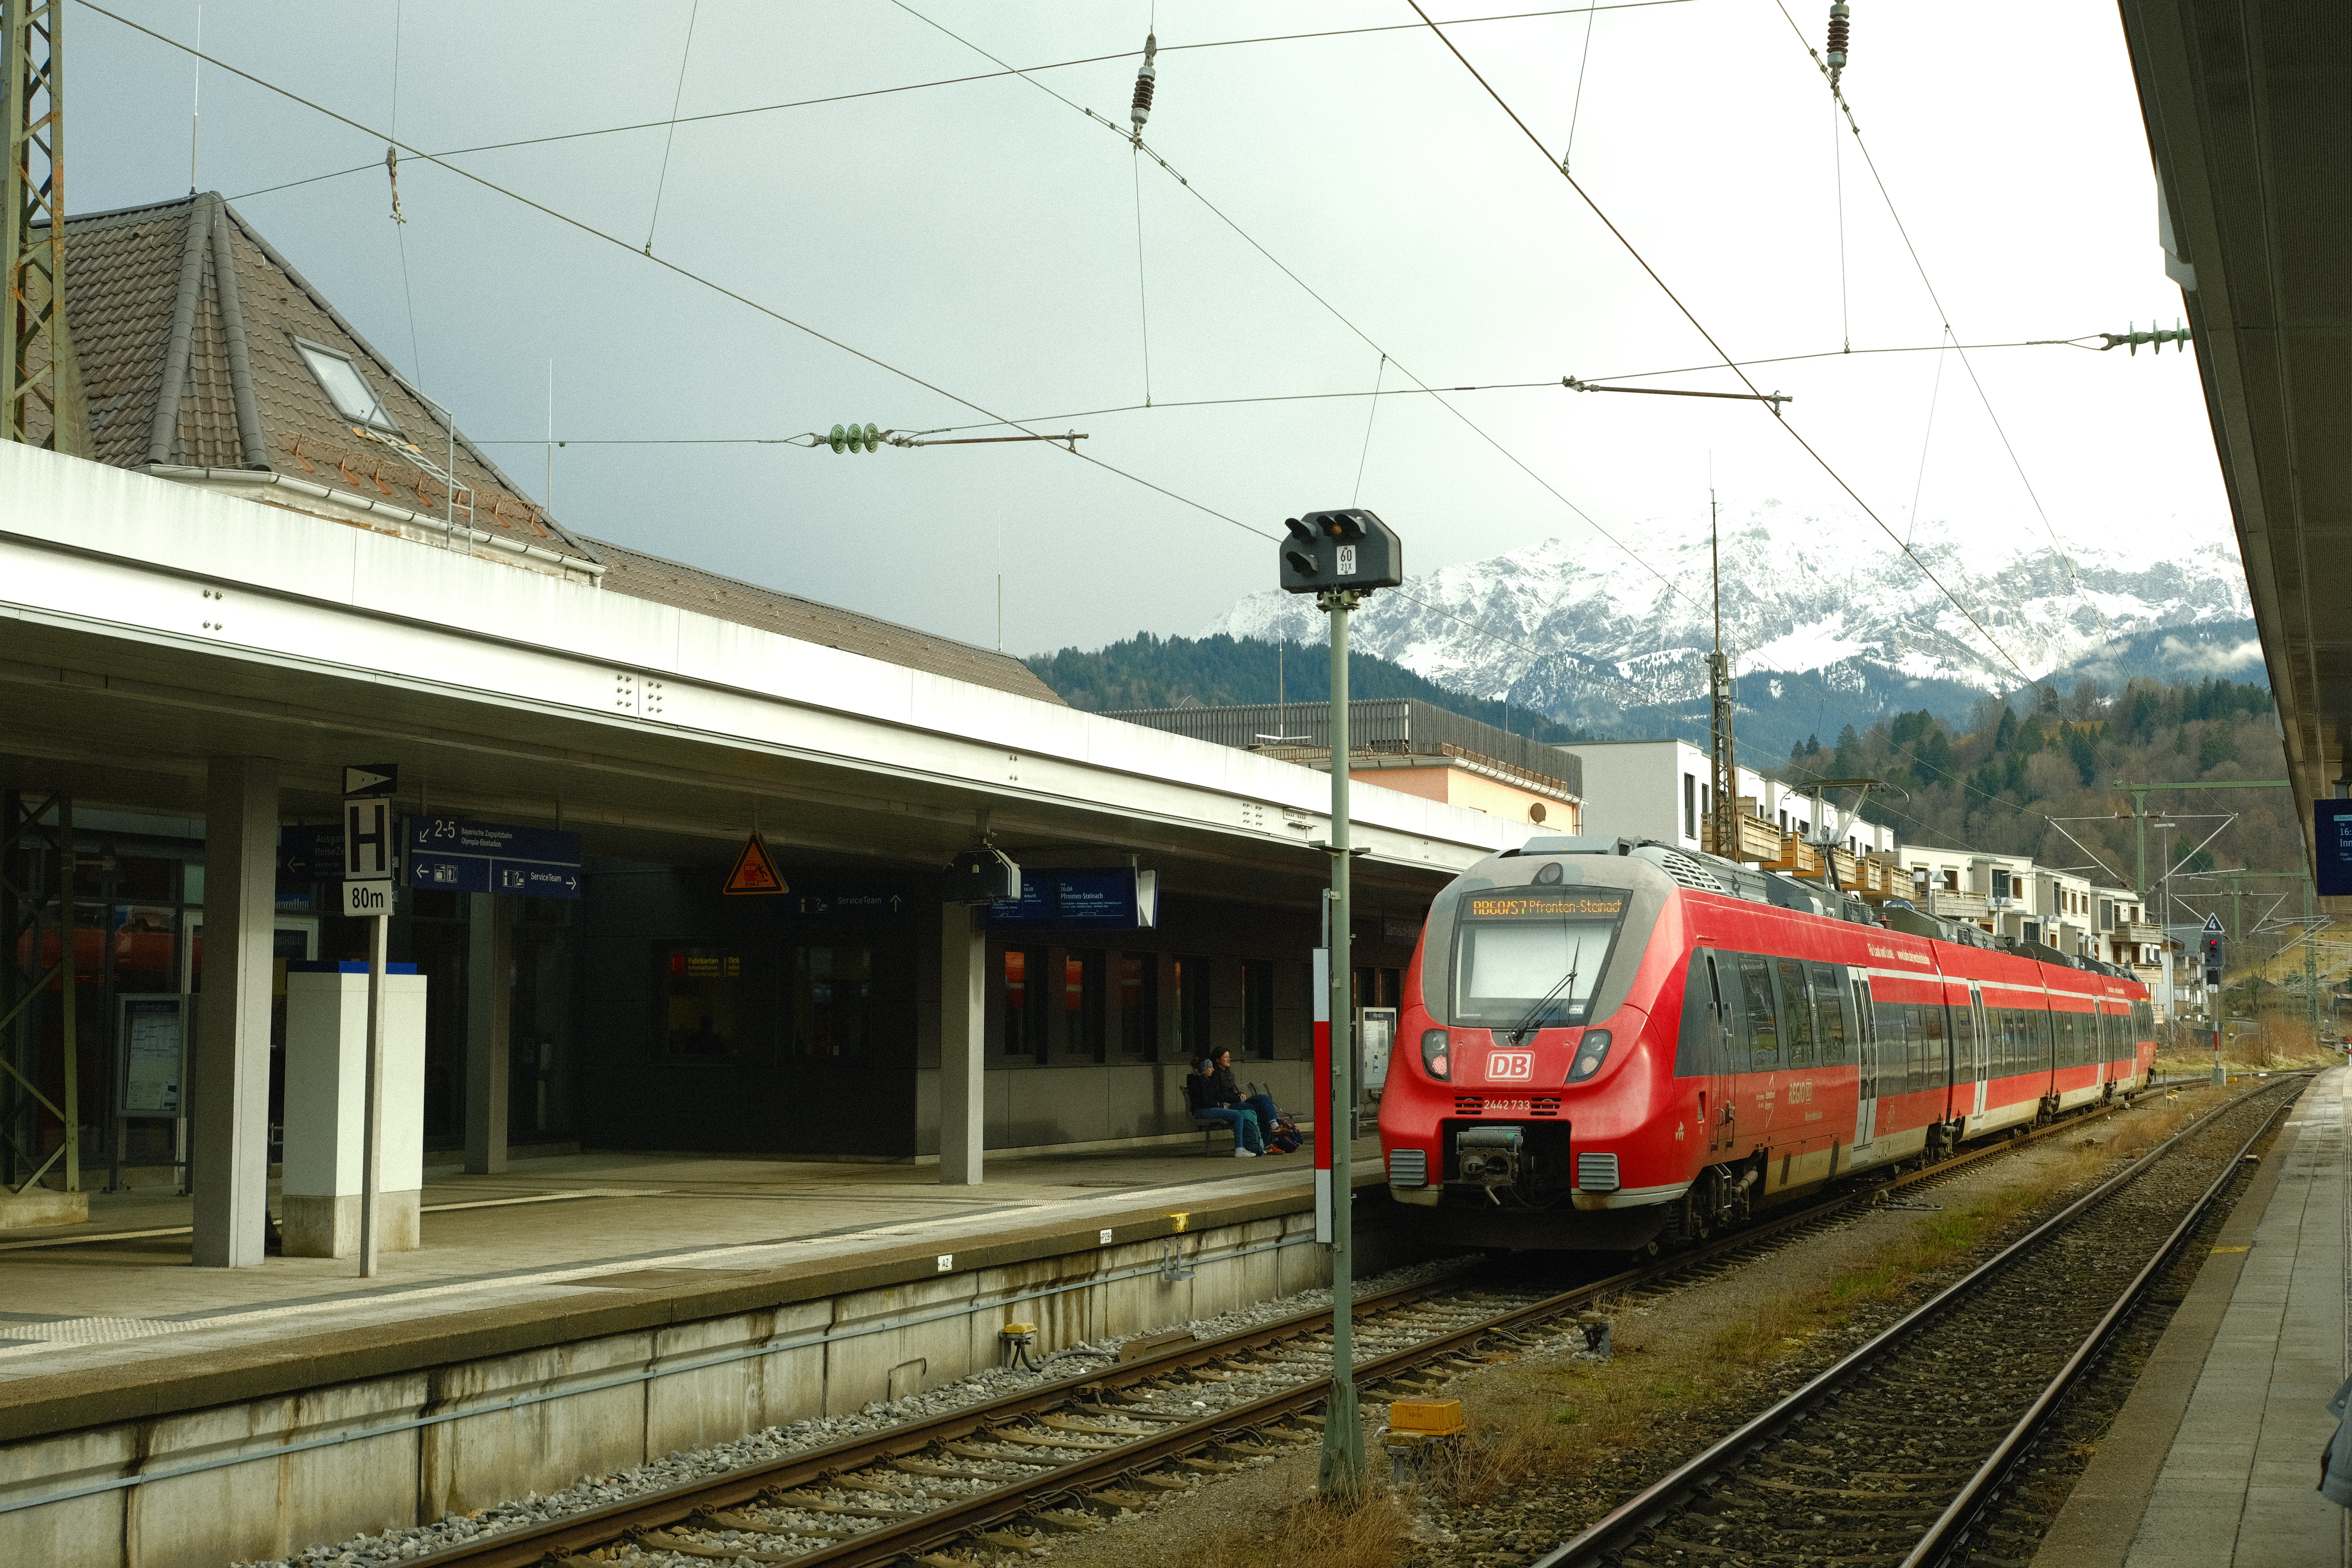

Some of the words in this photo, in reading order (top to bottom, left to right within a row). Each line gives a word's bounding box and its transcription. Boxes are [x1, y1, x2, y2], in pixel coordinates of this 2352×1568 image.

[1341, 550, 1352, 562] 60
[435, 820, 455, 838] 2-5
[461, 827, 484, 836] Bayerische
[485, 830, 513, 839] Zugspitzbahn
[350, 805, 385, 872] H
[461, 837, 502, 847] Olympia-Eisstadion
[530, 872, 562, 882] ServiceTeam
[352, 888, 384, 908] 80m
[837, 896, 882, 904] ServiceTeam
[2209, 919, 2216, 929] 4
[1492, 1056, 1527, 1076] DB
[1788, 1081, 1805, 1105] REGIO
[1484, 1100, 1509, 1110] 2442
[1511, 1100, 1530, 1110] 733
[942, 1259, 949, 1268] AZ
